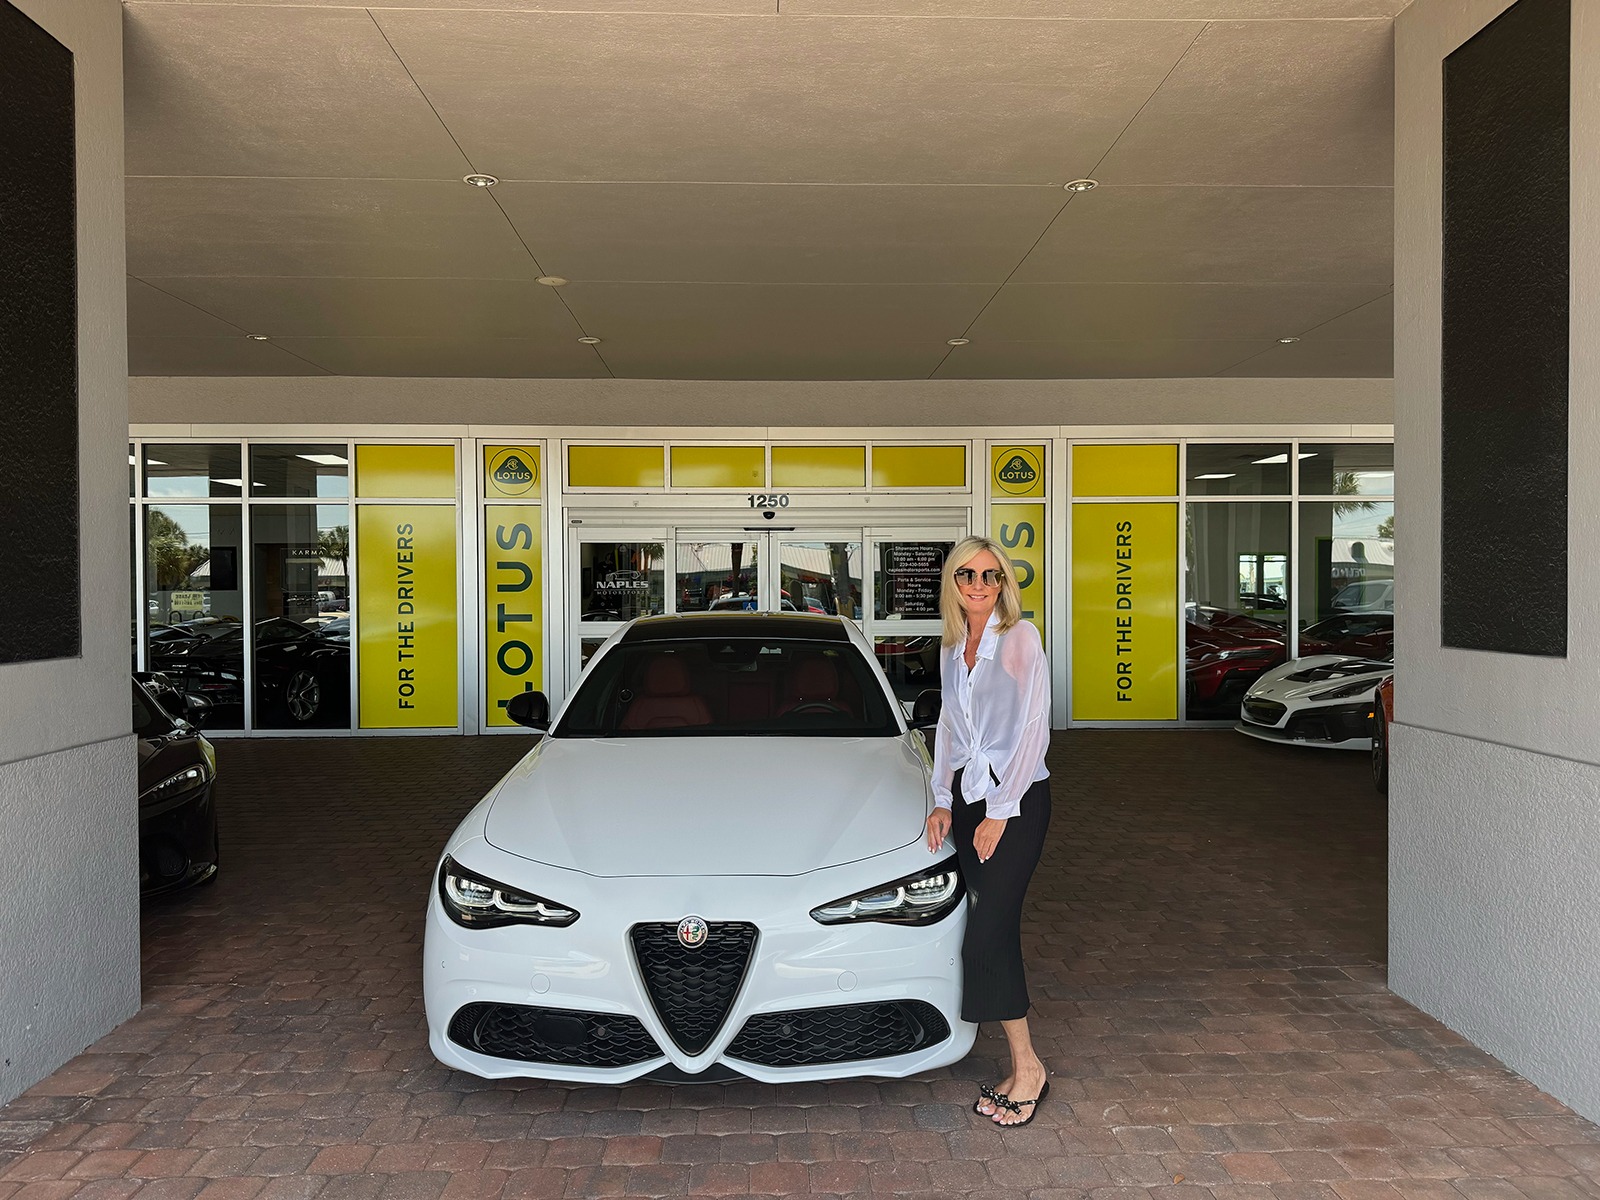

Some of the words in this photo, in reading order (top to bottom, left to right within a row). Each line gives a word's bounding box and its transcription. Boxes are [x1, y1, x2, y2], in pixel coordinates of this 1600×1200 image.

[497, 472, 530, 480] LOTUS
[1002, 472, 1034, 480] LOTUS
[748, 494, 790, 508] 1250
[397, 523, 414, 614] DRIVERS
[1116, 521, 1132, 610] DRIVERS
[398, 621, 414, 662] THE
[1116, 616, 1132, 656] THE
[398, 668, 415, 708] FOR
[1116, 662, 1132, 702] FOR
